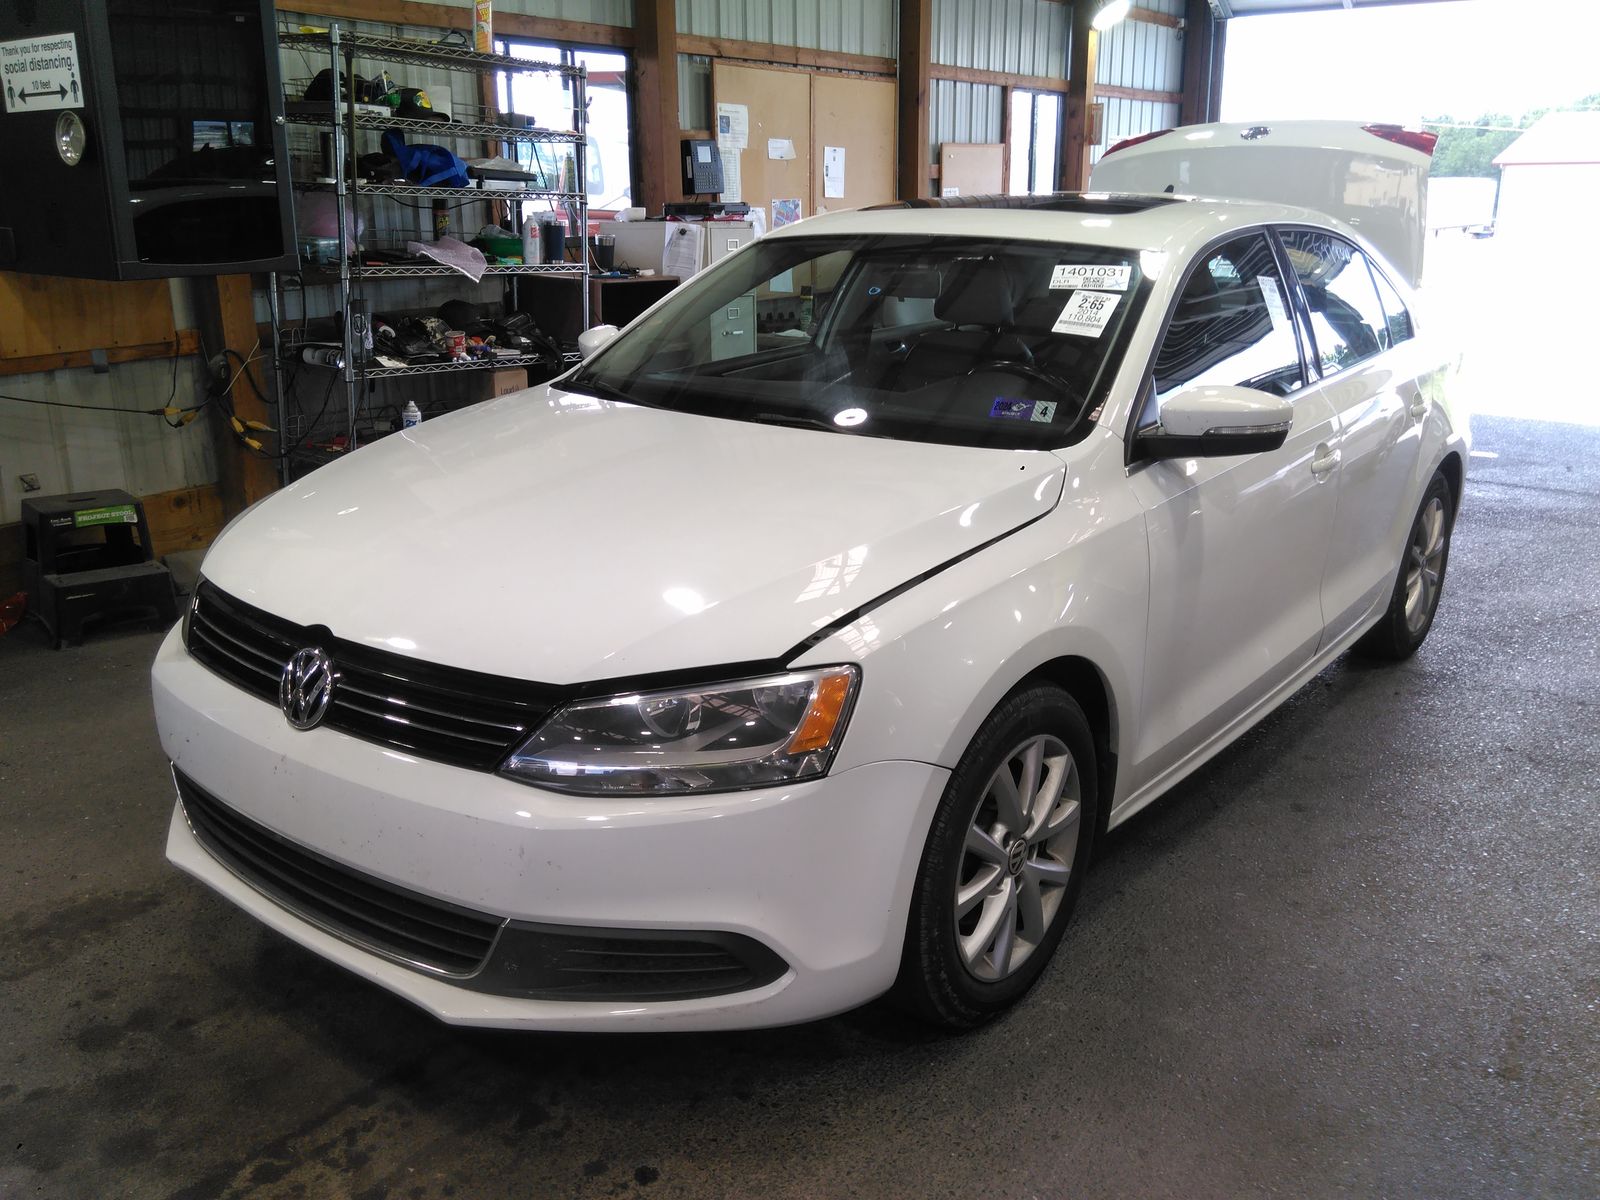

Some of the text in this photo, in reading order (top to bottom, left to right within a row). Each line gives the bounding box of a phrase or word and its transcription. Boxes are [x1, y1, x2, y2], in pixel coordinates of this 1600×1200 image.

[1, 39, 72, 57] Thank you for respecting
[4, 54, 75, 74] social distancing.
[32, 79, 52, 90] 10 feet
[1060, 267, 1123, 277] 1401031
[1077, 308, 1098, 316] 2014
[1039, 406, 1049, 417] 4
